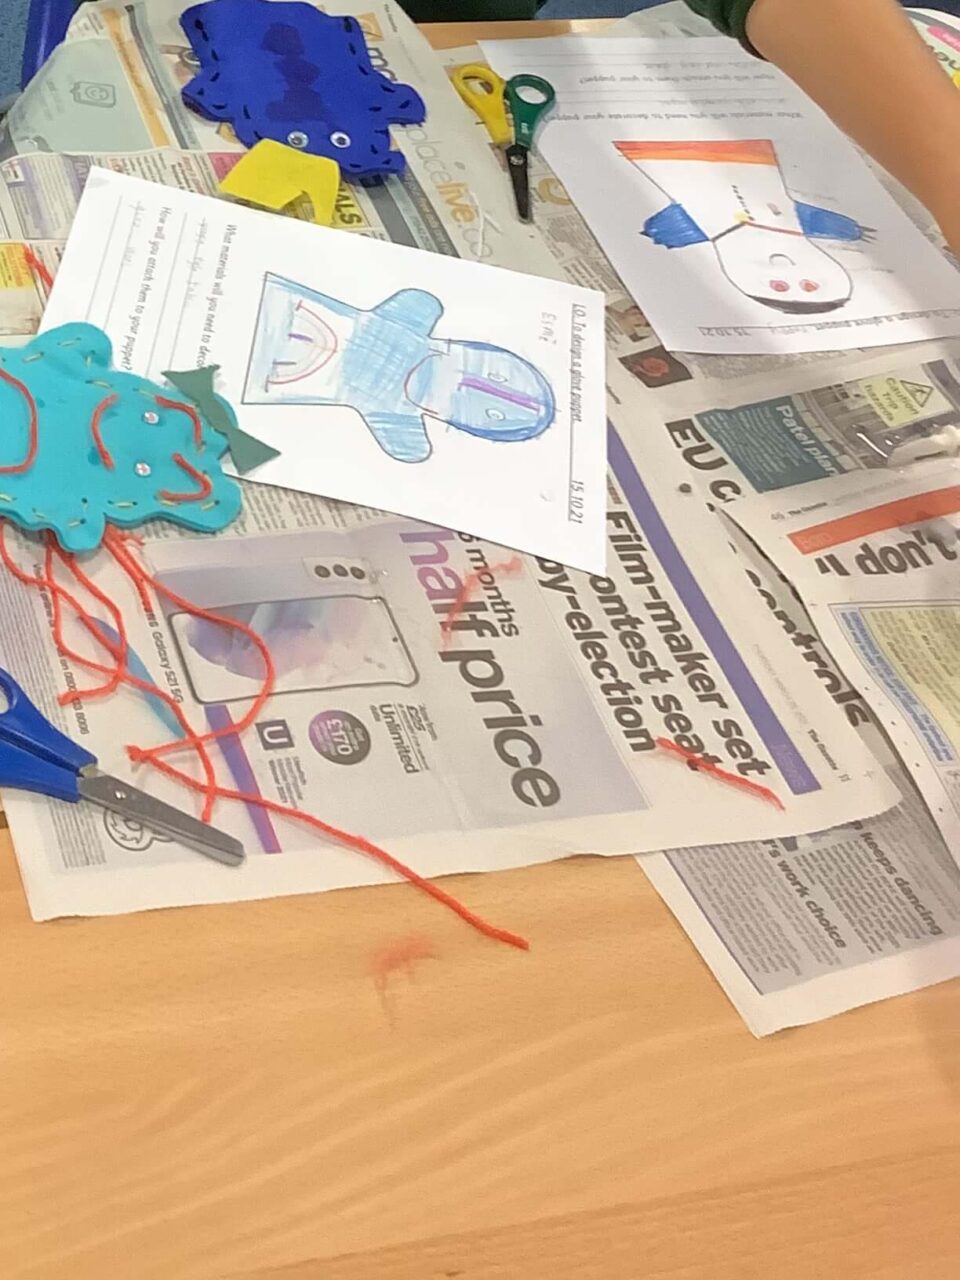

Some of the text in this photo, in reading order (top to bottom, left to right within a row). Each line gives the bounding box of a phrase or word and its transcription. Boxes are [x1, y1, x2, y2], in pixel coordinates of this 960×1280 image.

[157, 205, 172, 225] How
[153, 225, 167, 240] will
[222, 223, 237, 244] What
[144, 239, 161, 256] you
[141, 256, 158, 282] attach
[214, 244, 231, 280] materials
[135, 282, 153, 303] them
[211, 281, 225, 296] will
[133, 304, 145, 313] to
[203, 296, 216, 312] you
[124, 314, 142, 334] your
[202, 312, 216, 332] need
[573, 321, 586, 333] To
[200, 334, 210, 342] to
[569, 333, 584, 360] design
[116, 335, 140, 370] puppet?
[568, 369, 584, 391] glove
[568, 391, 583, 422] puppet
[776, 405, 813, 454] Patel
[664, 418, 729, 471] EU
[465, 548, 519, 637] months
[605, 511, 729, 709] Film-maker
[712, 719, 772, 776] set
[150, 630, 173, 669] Galaxy
[164, 670, 179, 687] S21
[399, 531, 561, 808] half price
[589, 576, 724, 771] ontest seat
[324, 718, 355, 755] £170
[378, 704, 419, 773] Unlimited
[860, 831, 944, 935] keeps dancing
[777, 860, 811, 898] work
[806, 899, 846, 949] choice
